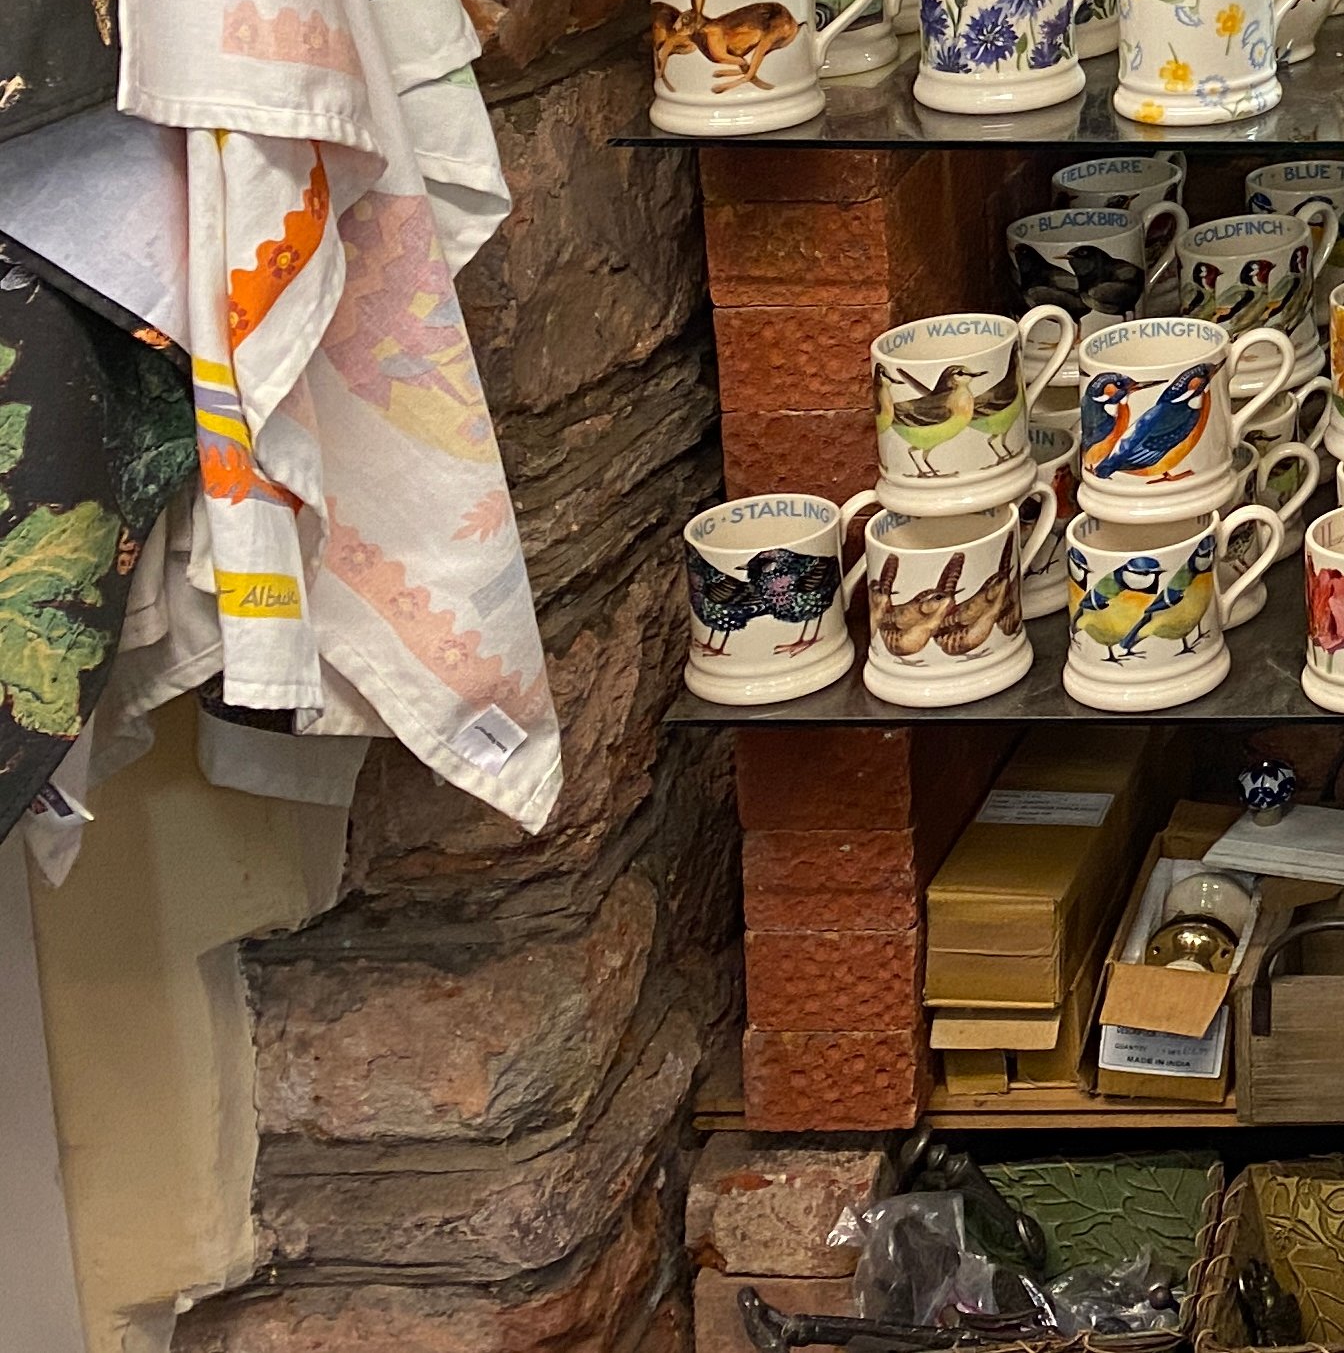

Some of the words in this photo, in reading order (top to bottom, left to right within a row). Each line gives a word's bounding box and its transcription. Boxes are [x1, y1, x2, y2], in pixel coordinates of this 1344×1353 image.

[1060, 159, 1144, 184] FIELDFARE
[1283, 164, 1332, 182] BLUE
[1038, 211, 1129, 234] BLACKBIRD
[1193, 219, 1284, 247] GOLDFINCH
[926, 320, 1006, 339] WAGTAIL
[729, 500, 831, 525] STARLING
[1126, 1056, 1154, 1065] MADE
[1165, 1058, 1191, 1067] INDIA
